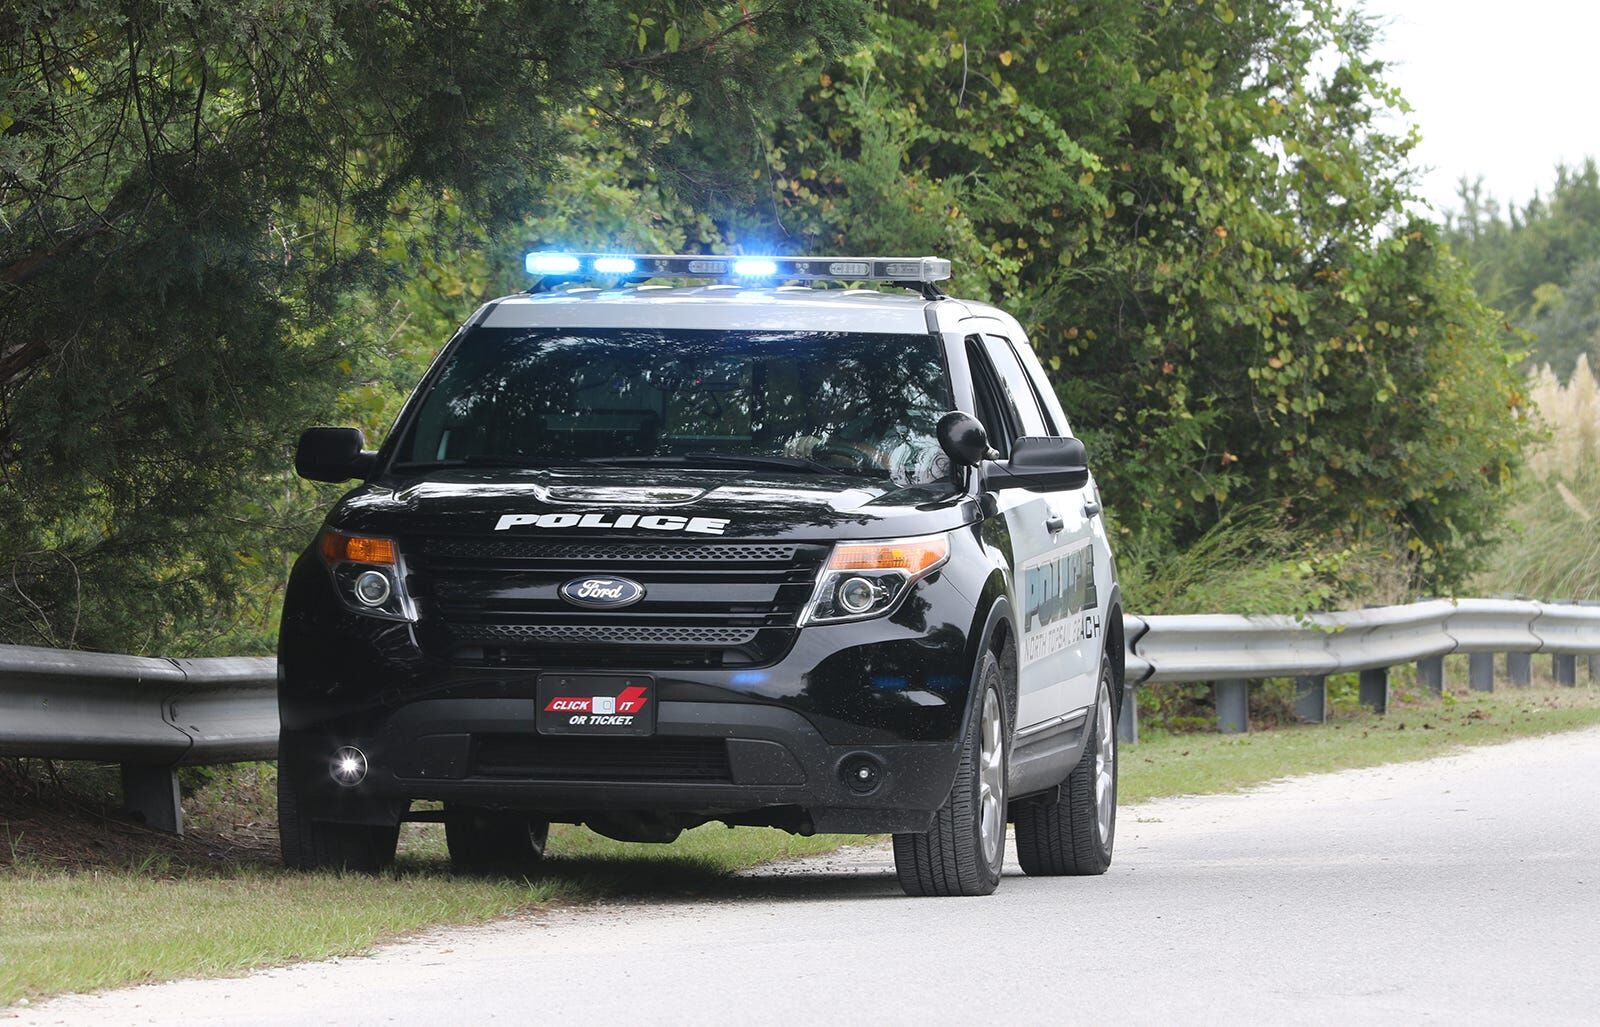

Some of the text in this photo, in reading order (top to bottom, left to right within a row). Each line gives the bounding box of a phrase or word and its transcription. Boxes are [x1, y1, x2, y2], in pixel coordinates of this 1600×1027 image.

[494, 513, 731, 535] POLICE
[577, 579, 623, 599] Ford
[552, 700, 635, 711] CLICK IT
[569, 715, 634, 725] OR TICKET.
